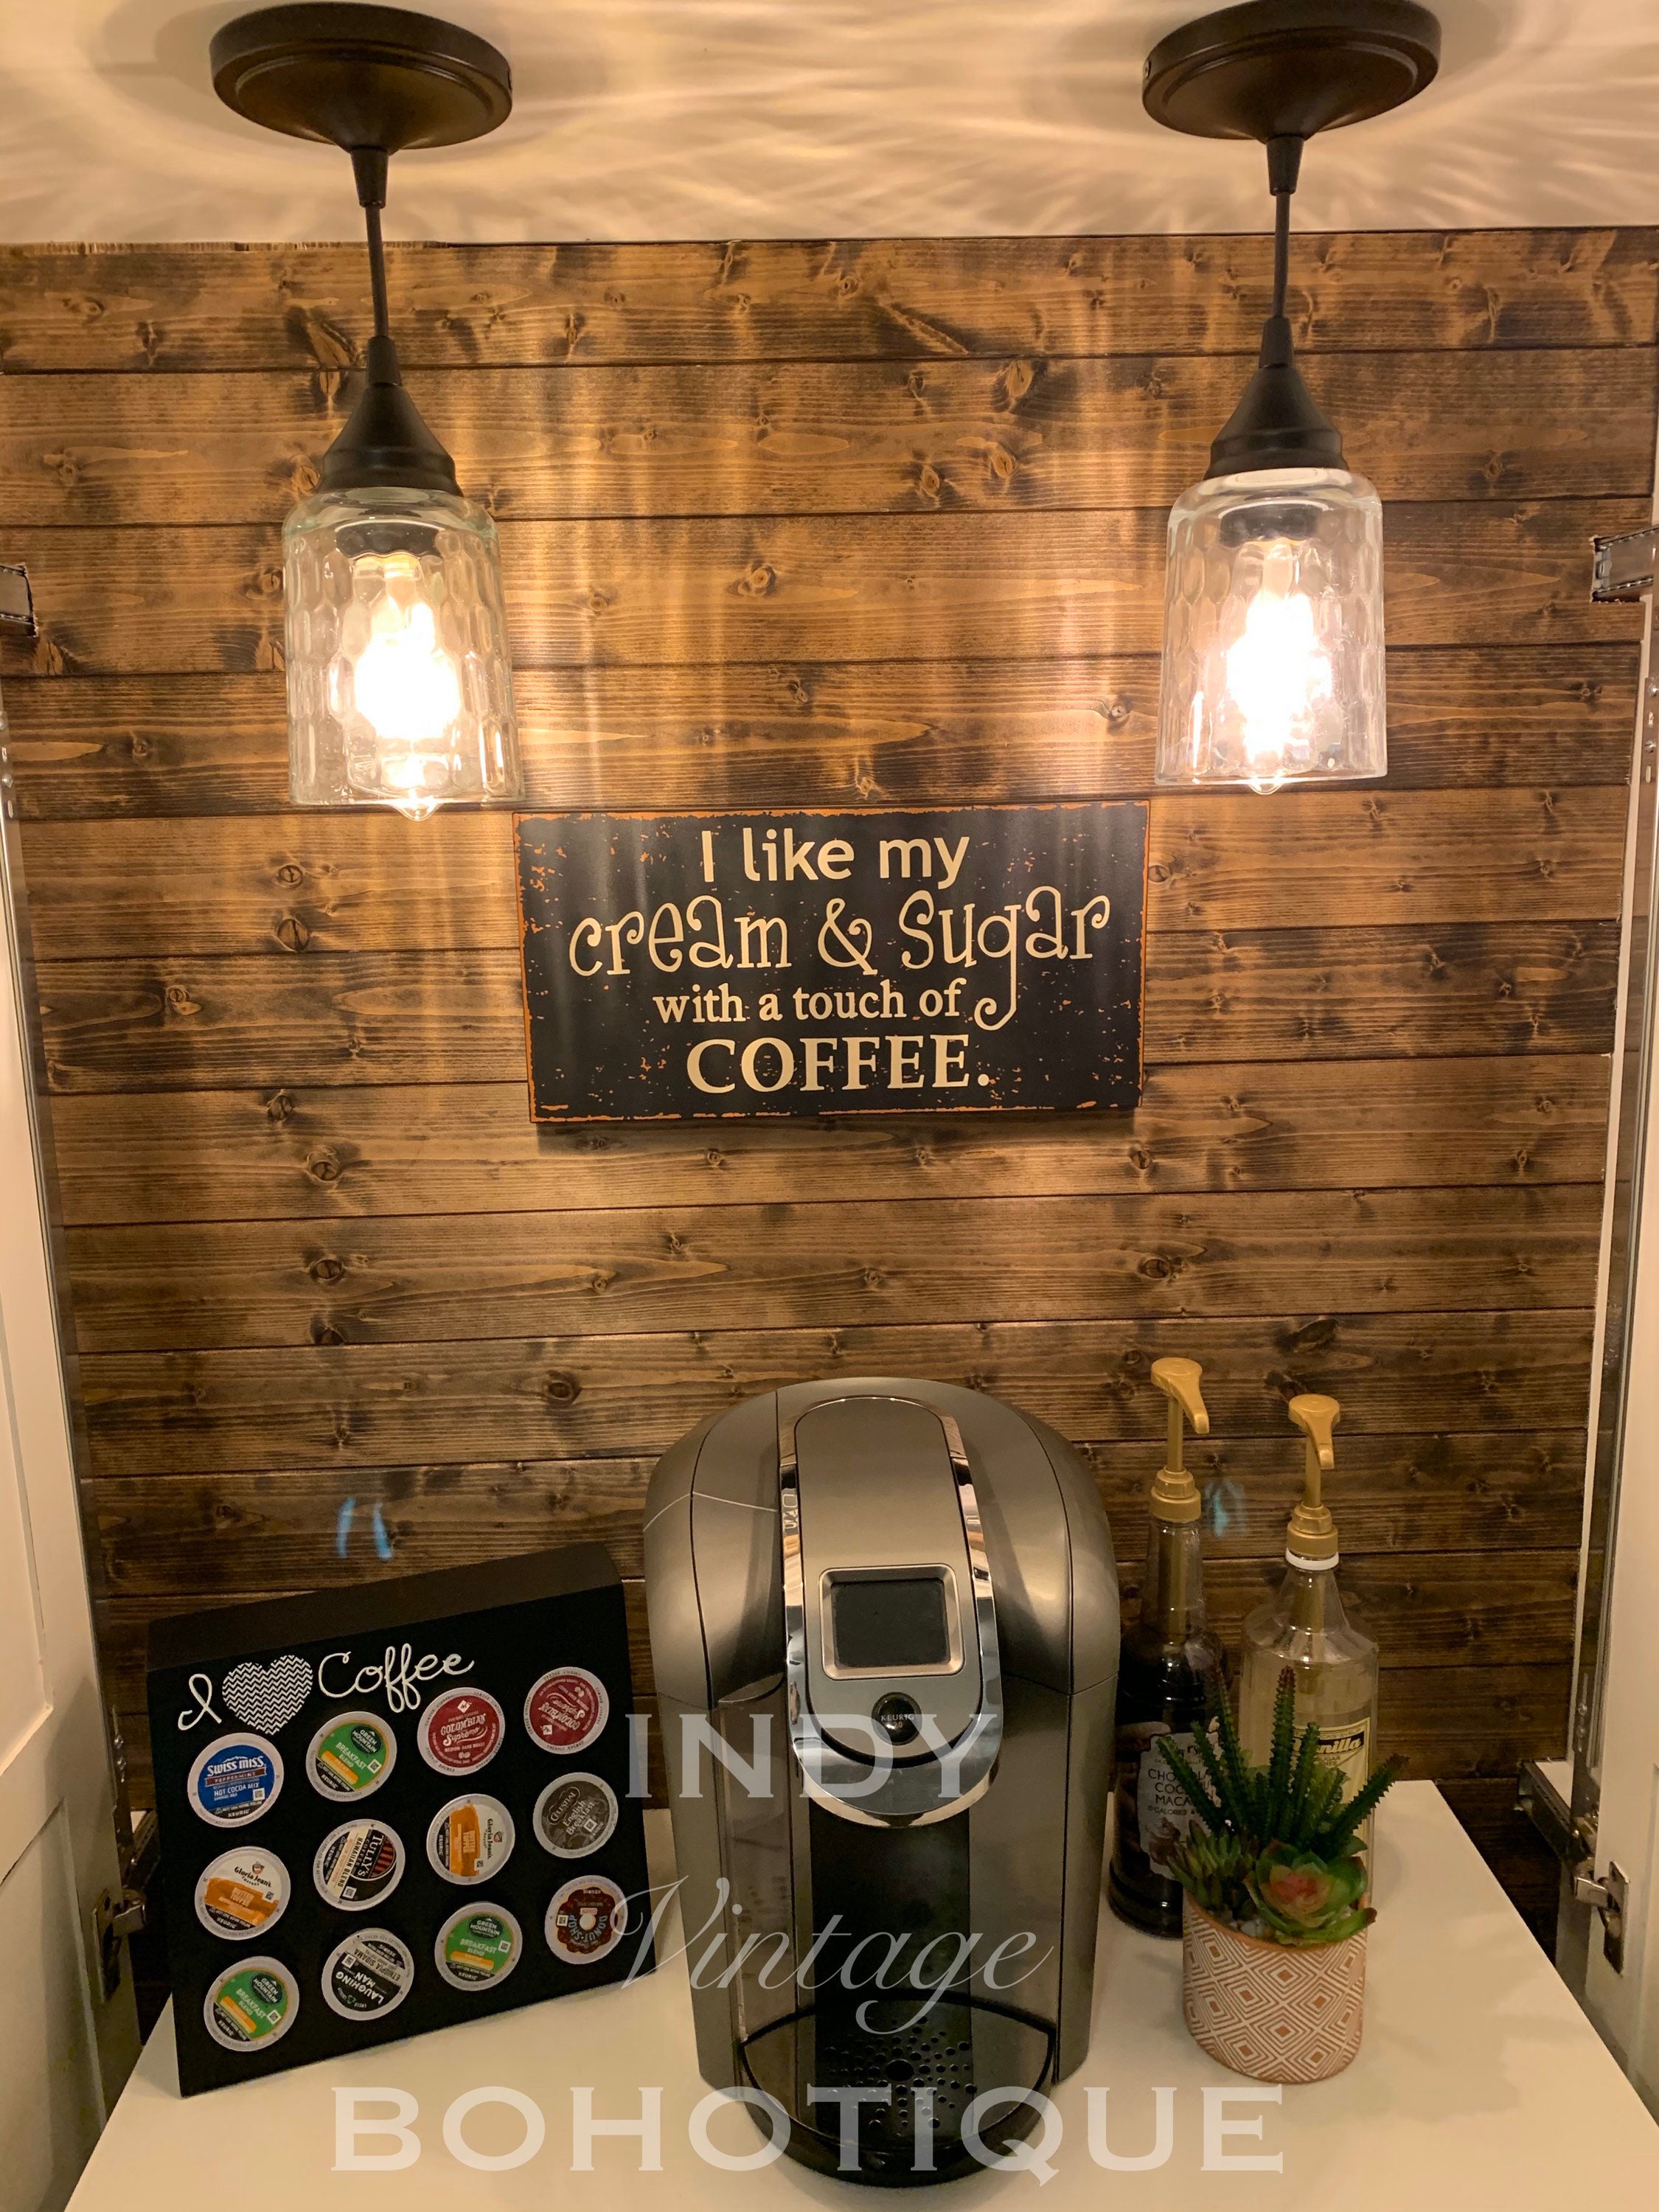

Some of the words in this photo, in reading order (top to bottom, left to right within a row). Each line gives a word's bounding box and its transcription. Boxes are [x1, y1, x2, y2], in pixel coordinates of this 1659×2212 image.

[702, 831, 714, 882] I
[743, 828, 855, 881] like
[880, 836, 970, 889] my
[570, 894, 792, 976] cream
[818, 898, 877, 975] &
[653, 984, 745, 1023] with
[759, 997, 782, 1021] a
[793, 978, 914, 1022] touch
[919, 978, 967, 1017] of
[686, 1034, 990, 1094] COFFEE.
[177, 1673, 221, 1731] I
[319, 1644, 475, 1713] Coffee
[441, 1714, 487, 1736] COLOMBIAN
[880, 1714, 914, 1722] KEURIG
[352, 1731, 378, 1753] MOUNTAIN
[360, 1730, 378, 1745] GREEN
[335, 1742, 367, 1770] BREAKFAST
[338, 1753, 354, 1768] BLEND
[214, 1789, 226, 1797] HOT
[227, 1784, 247, 1793] COCOA
[347, 1837, 364, 1867] HAWAIIAN
[357, 1834, 384, 1877] TULLY'S
[234, 1865, 254, 1880] Gloria
[337, 1868, 351, 1888] BLEND
[470, 1923, 500, 1935] MOUNTAIN
[476, 1920, 497, 1930] GREEN
[459, 1938, 498, 1954] BREAKFAST
[253, 1978, 279, 2003] MOUNTAIN
[261, 1978, 279, 1995] GREEN
[335, 1971, 384, 2005] LAUGHING
[355, 1972, 376, 1988] MAN
[236, 1988, 266, 2019] BREAKFAST
